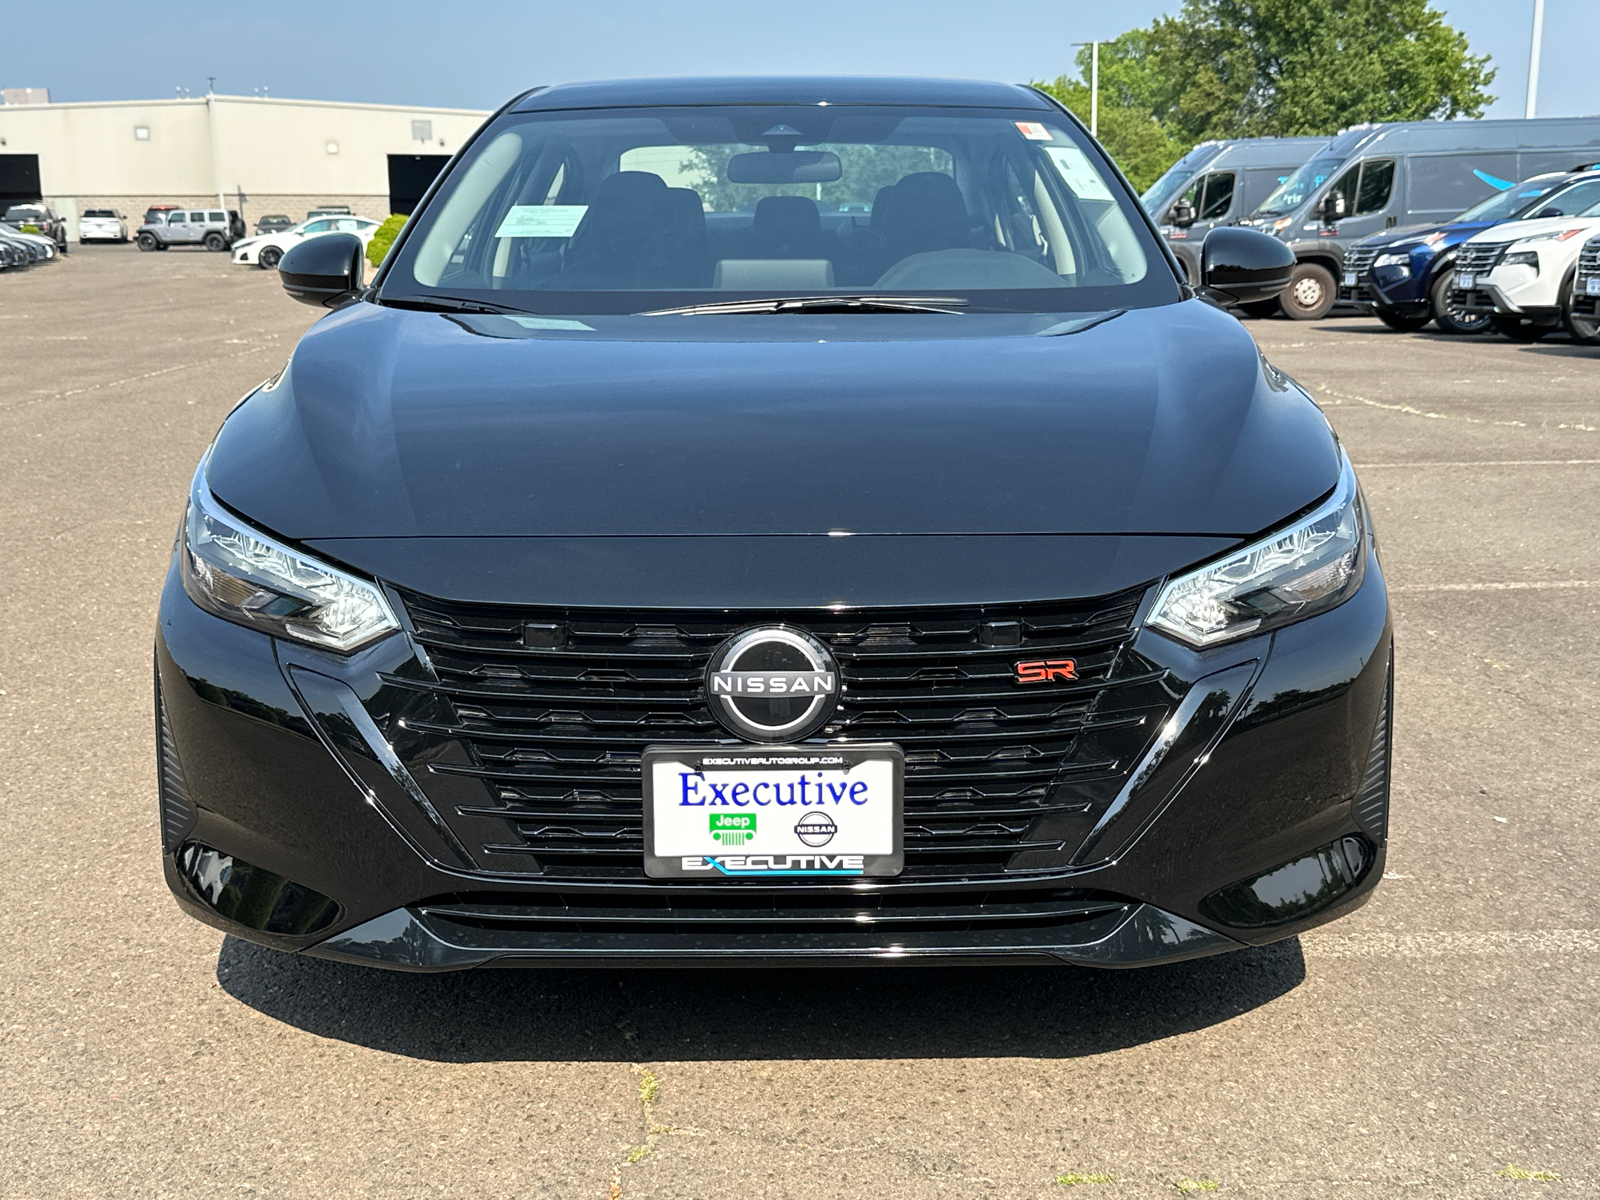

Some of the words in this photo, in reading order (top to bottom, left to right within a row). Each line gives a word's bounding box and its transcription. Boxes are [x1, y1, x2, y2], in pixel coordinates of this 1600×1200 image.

[1016, 659, 1079, 683] SR
[713, 675, 832, 693] NISSAN
[702, 757, 843, 766] EXECUTIVEAUTOGROUP.COM
[678, 772, 869, 807] Executive
[715, 814, 751, 829] Jeep
[796, 825, 836, 834] NISSAN
[681, 855, 865, 873] EXECUTIVE
